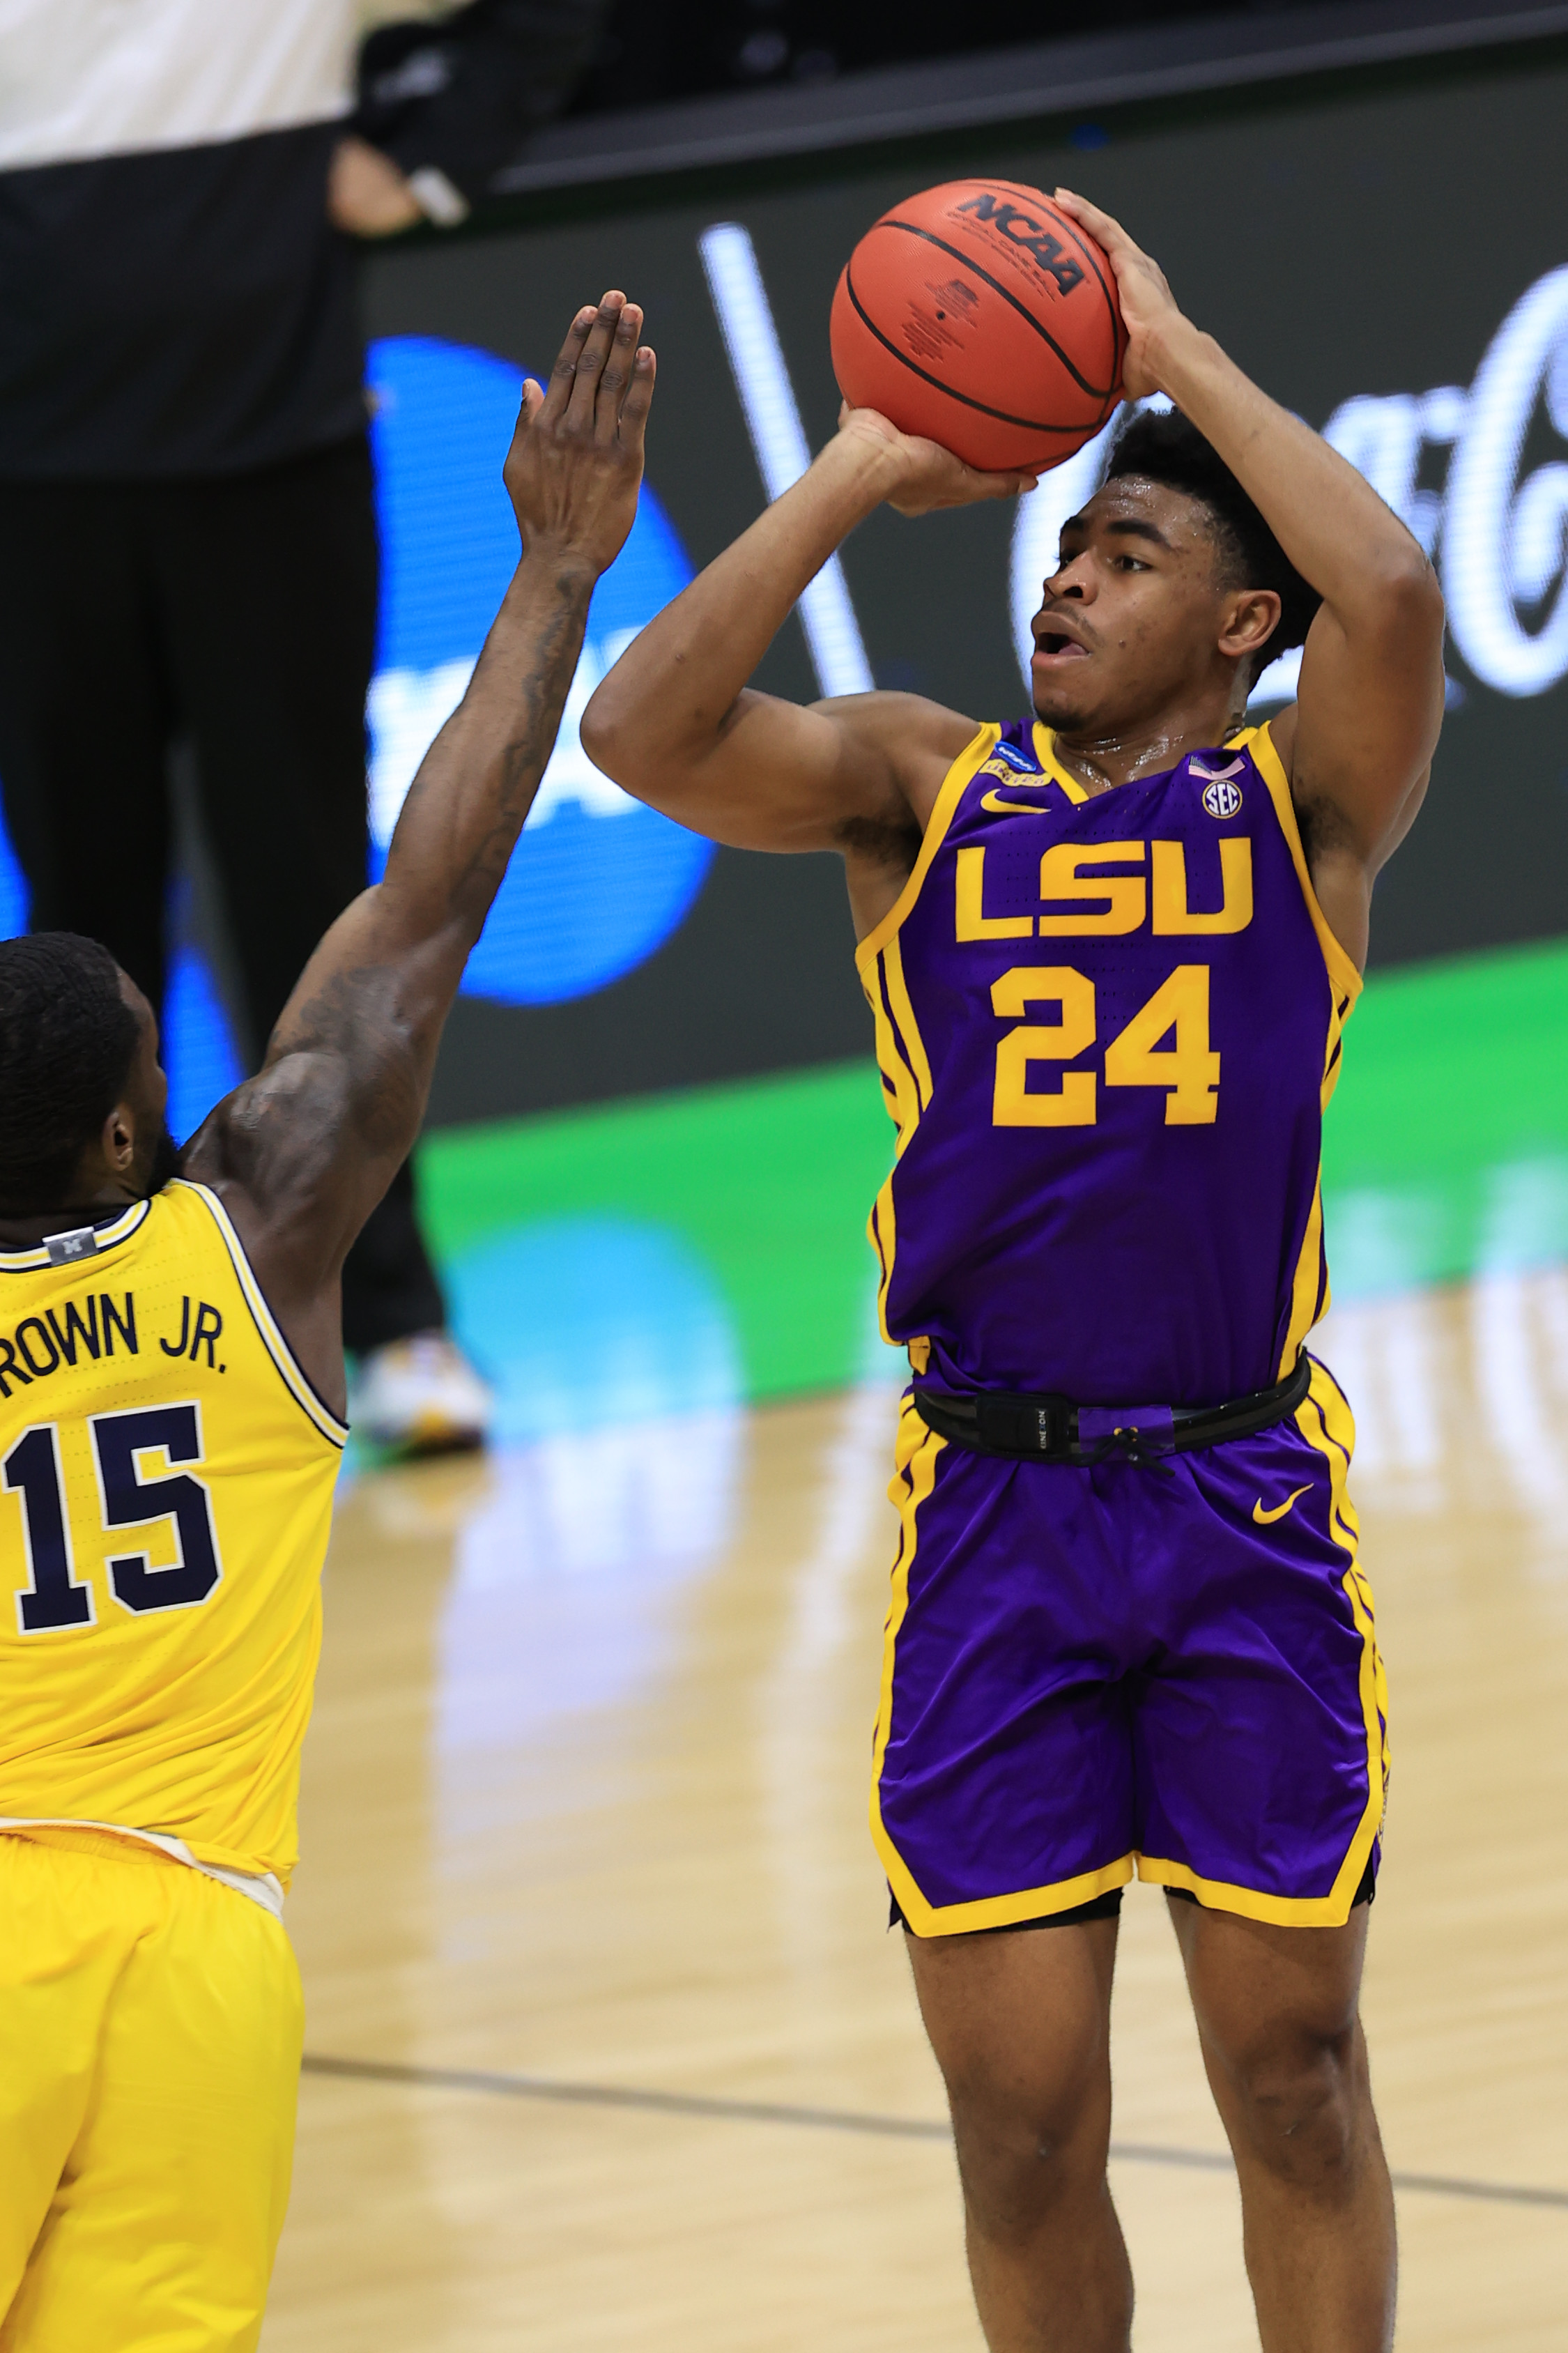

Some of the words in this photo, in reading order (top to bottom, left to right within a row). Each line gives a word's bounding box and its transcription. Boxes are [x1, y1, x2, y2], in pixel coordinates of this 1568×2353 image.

[957, 193, 1085, 297] NCAA
[1206, 783, 1239, 815] SEC
[955, 837, 1253, 942] LSU
[990, 965, 1220, 1126] 24
[160, 1296, 226, 1374] JR.
[0, 1399, 224, 1636] 15
